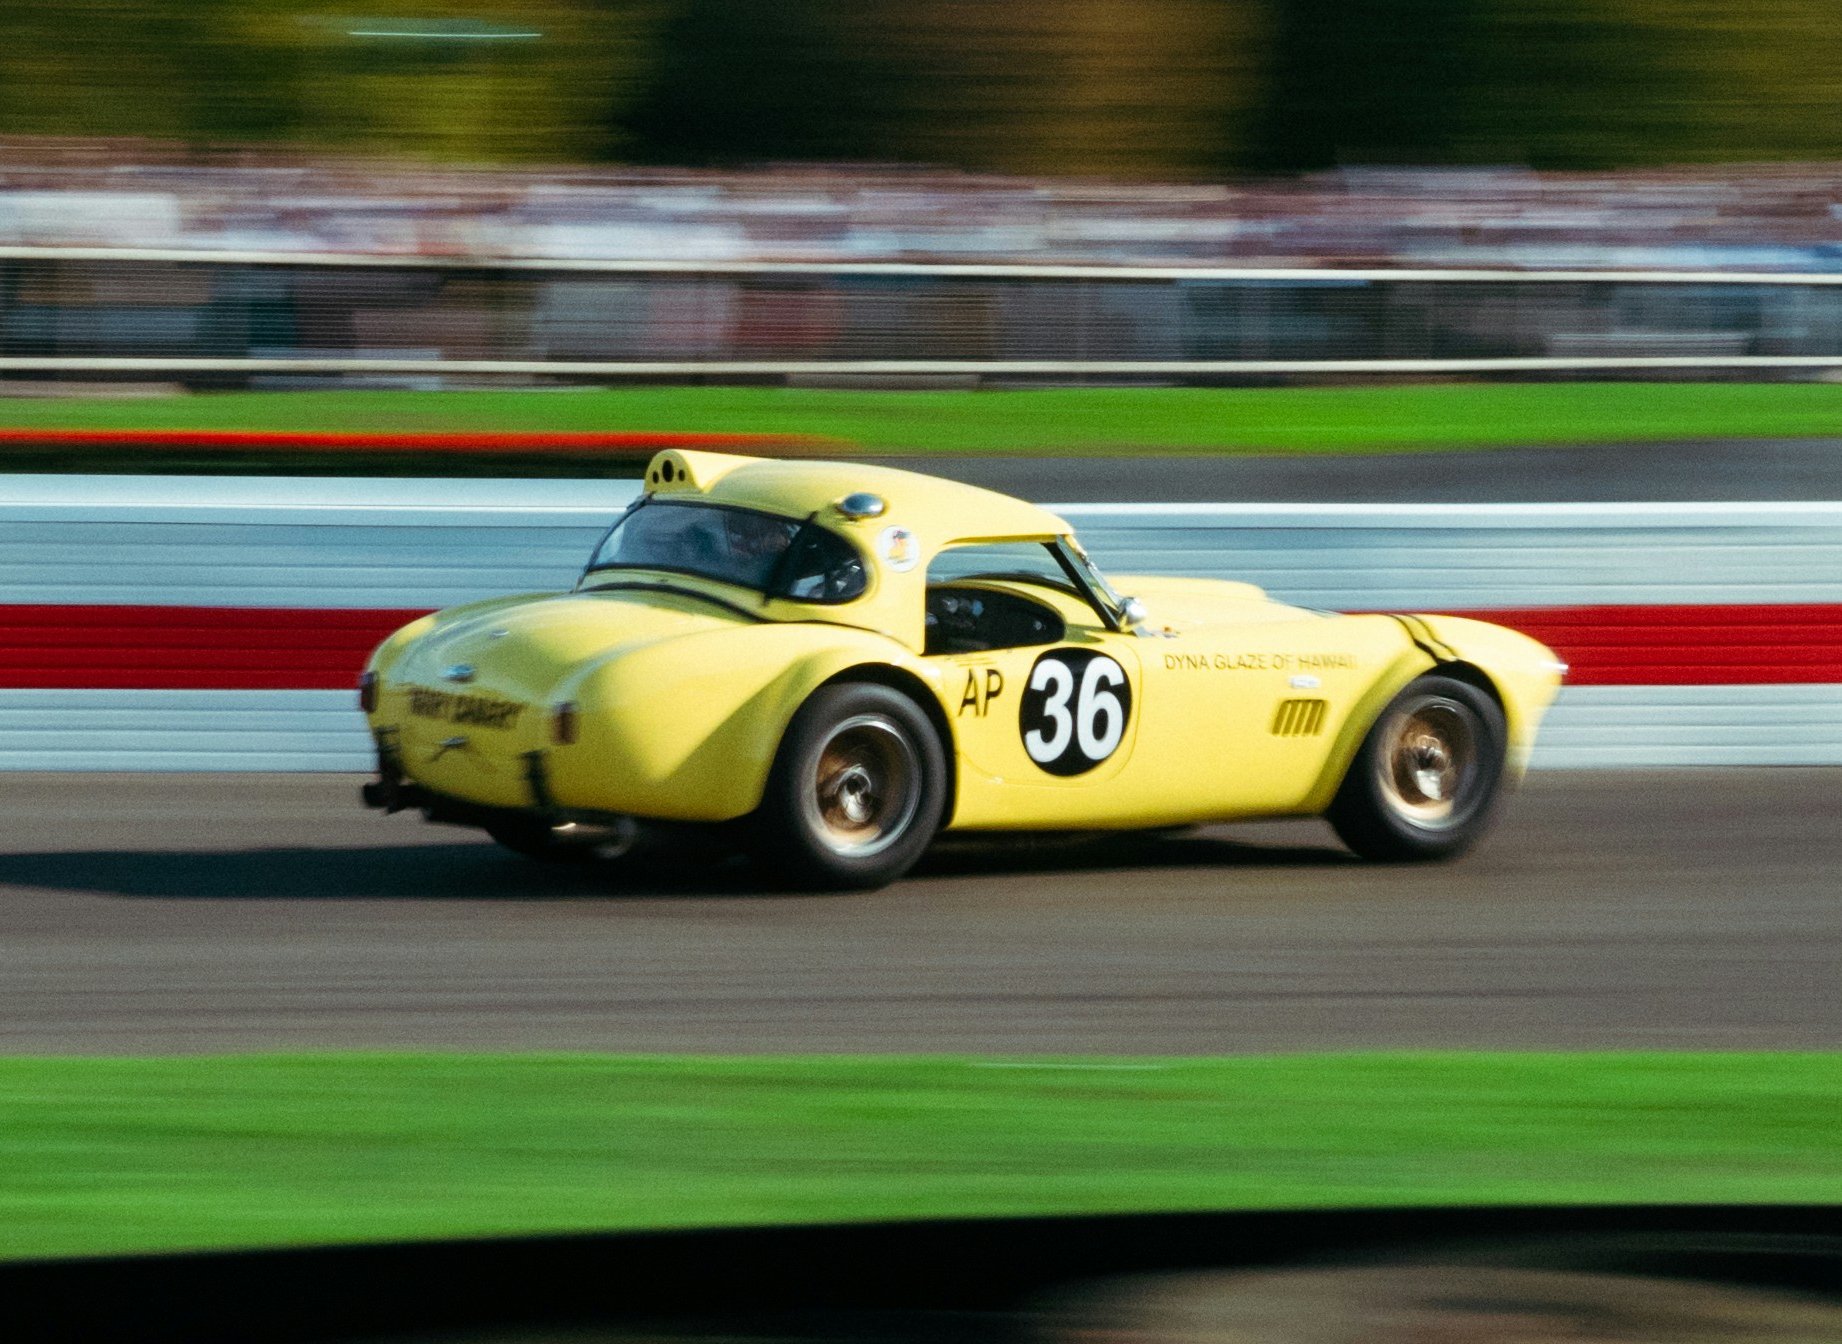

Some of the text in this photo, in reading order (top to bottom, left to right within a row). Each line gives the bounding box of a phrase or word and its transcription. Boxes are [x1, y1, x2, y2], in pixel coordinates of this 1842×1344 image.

[1164, 654, 1209, 670] DYNA
[1214, 654, 1268, 670] GLAZE
[1272, 654, 1294, 669] OF
[958, 668, 1004, 717] AP
[1025, 656, 1124, 763] 36
